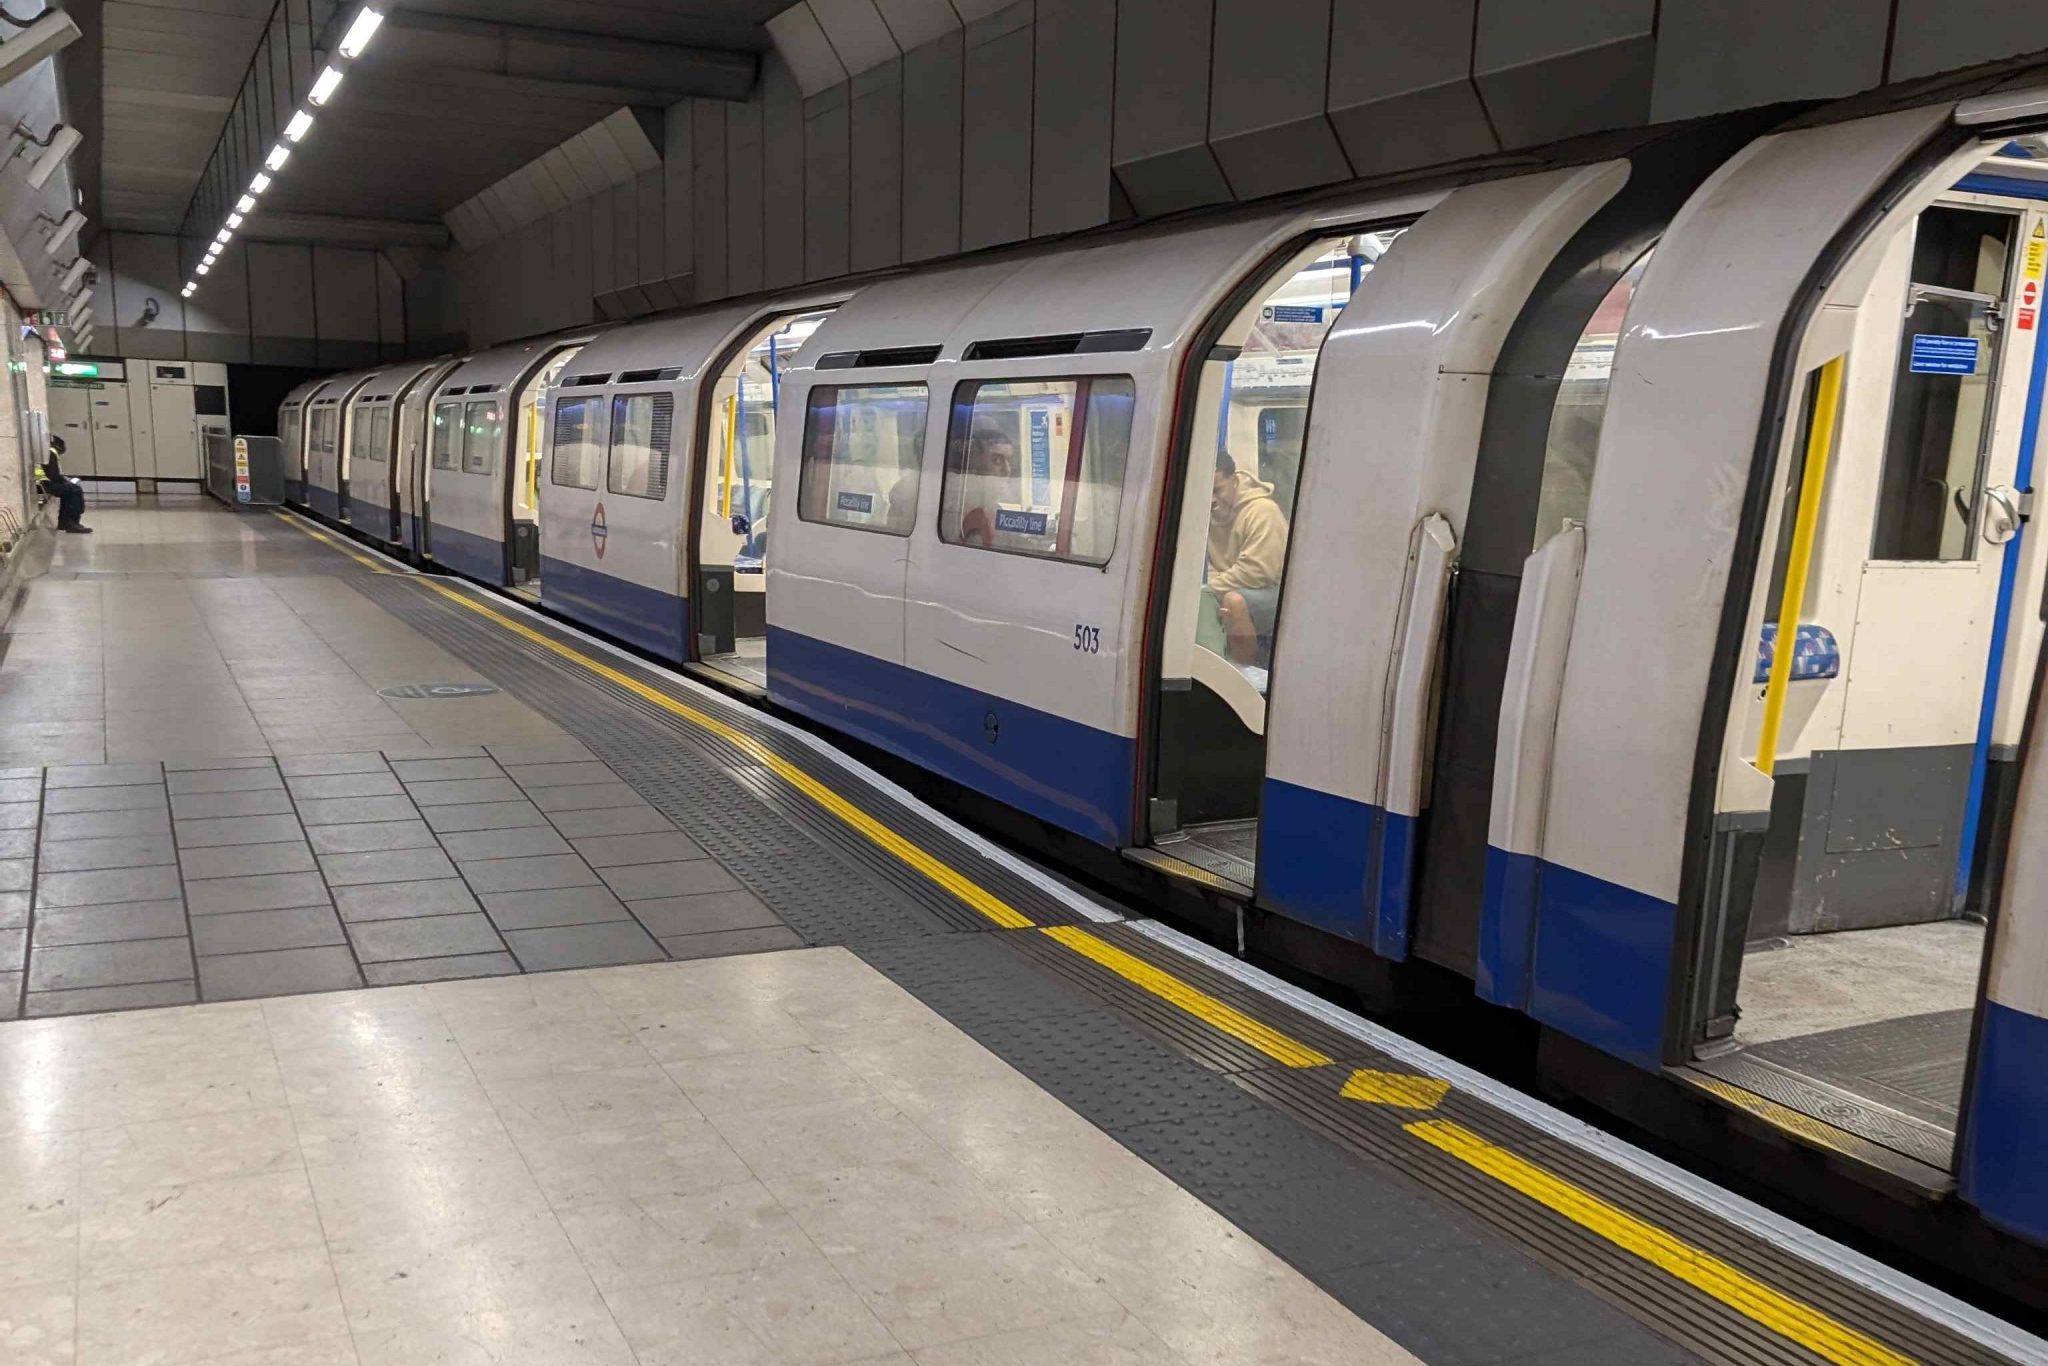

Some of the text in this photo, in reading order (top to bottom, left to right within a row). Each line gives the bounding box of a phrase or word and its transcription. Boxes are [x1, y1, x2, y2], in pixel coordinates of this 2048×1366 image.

[999, 513, 1042, 533] Piccadilly line
[1073, 624, 1100, 654] 503
